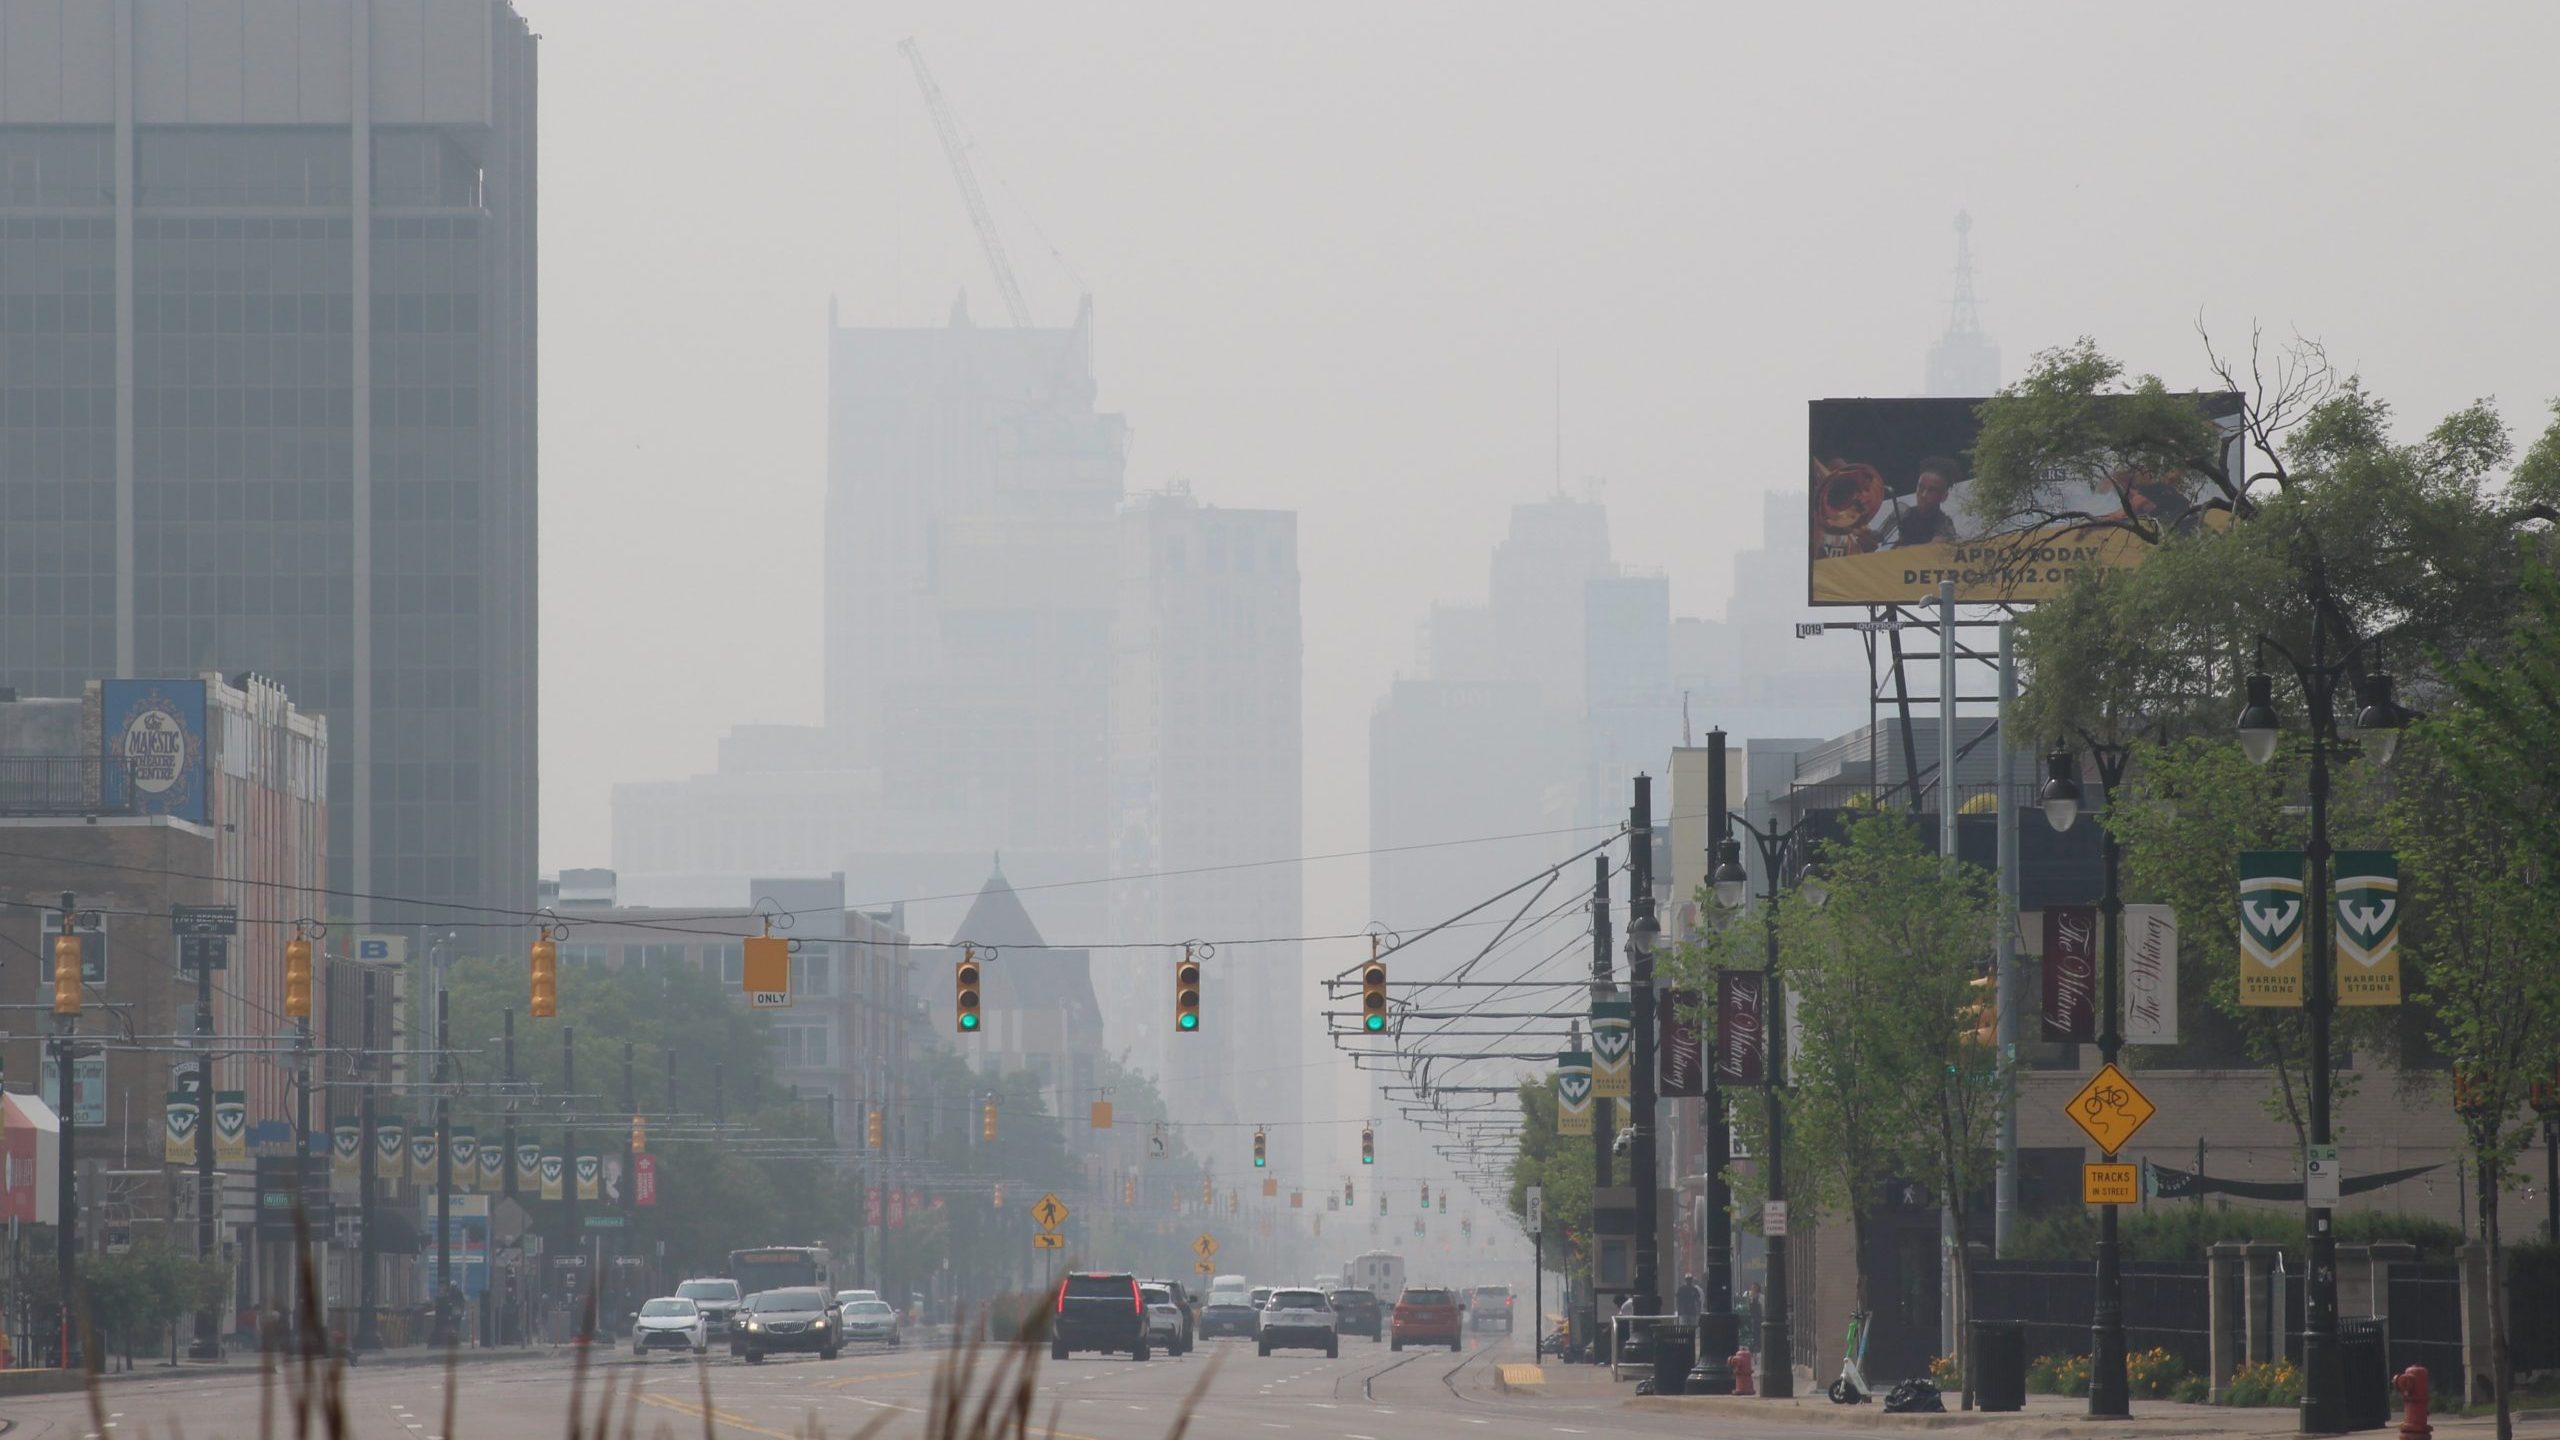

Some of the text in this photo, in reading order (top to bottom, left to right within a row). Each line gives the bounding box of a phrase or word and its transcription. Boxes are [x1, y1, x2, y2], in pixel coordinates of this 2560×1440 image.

[1801, 624, 1822, 635] 1019
[128, 730, 180, 756] MAJESTIC
[136, 767, 175, 780] CENTRE
[361, 940, 388, 959] B
[2044, 912, 2095, 1033] The Whitney
[2125, 915, 2175, 1035] The Whitney
[2246, 975, 2297, 984] WARRIOR
[2344, 974, 2394, 983] WARRIOR
[2250, 984, 2294, 993] STRONG
[2347, 983, 2391, 992] STRONG
[757, 993, 786, 1004] ONLY
[1730, 975, 1759, 1014] The
[1719, 1012, 1762, 1078] Whitney
[2311, 1162, 2318, 1170] 4
[2092, 1171, 2130, 1182] TRACKS
[2092, 1187, 2129, 1196] IN STREET
